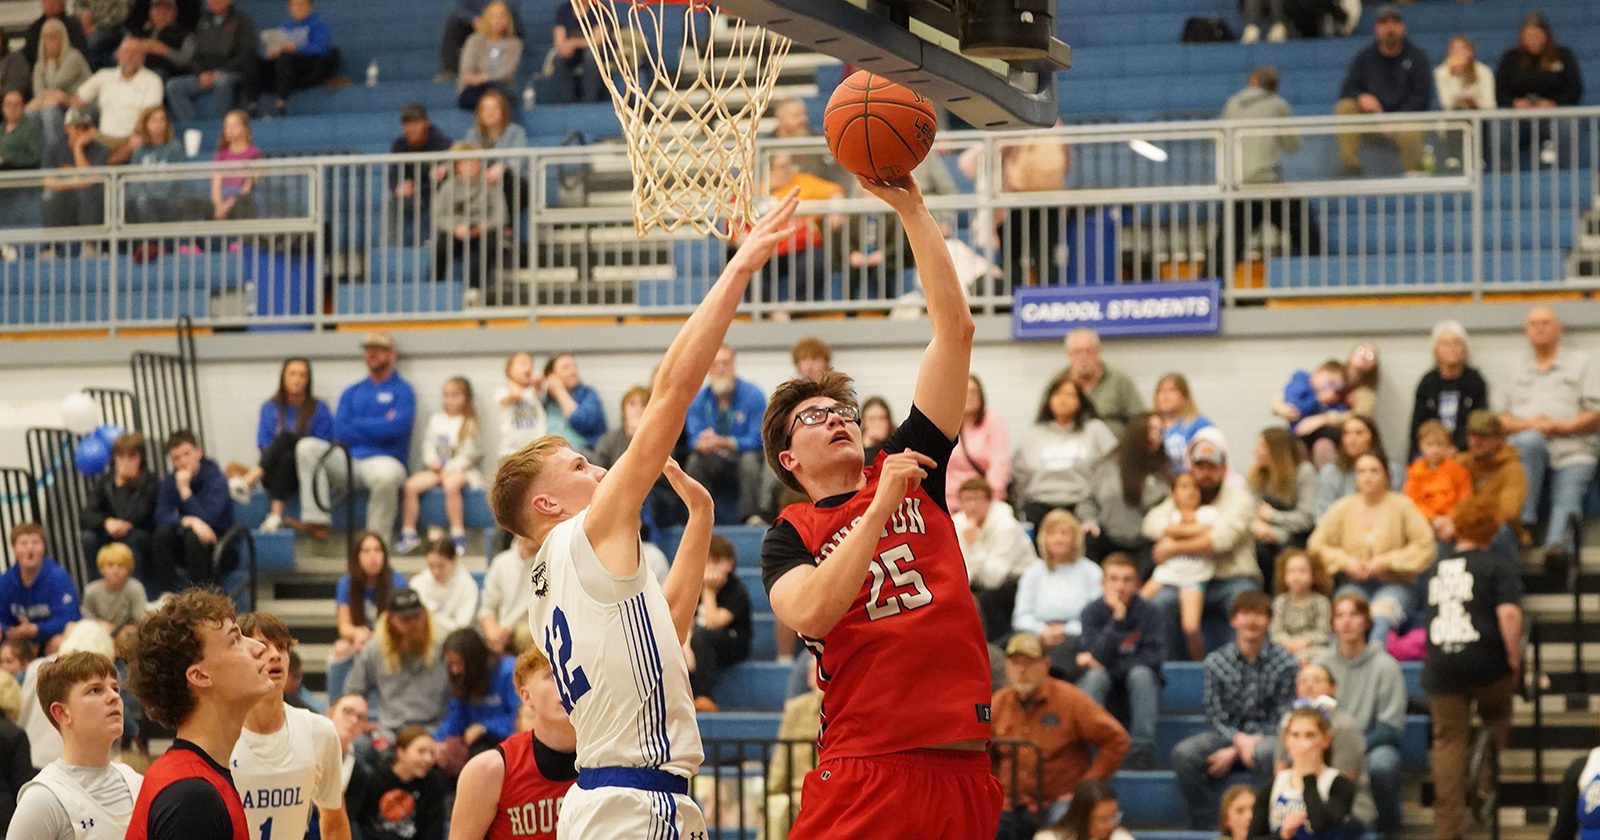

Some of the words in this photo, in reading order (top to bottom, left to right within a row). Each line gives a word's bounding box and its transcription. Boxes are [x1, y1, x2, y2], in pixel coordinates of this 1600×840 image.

[1021, 301, 1104, 323] CABOOL
[1106, 296, 1211, 320] STUDENTS
[865, 542, 933, 621] 25
[544, 605, 592, 716] 12
[259, 816, 273, 840] 1
